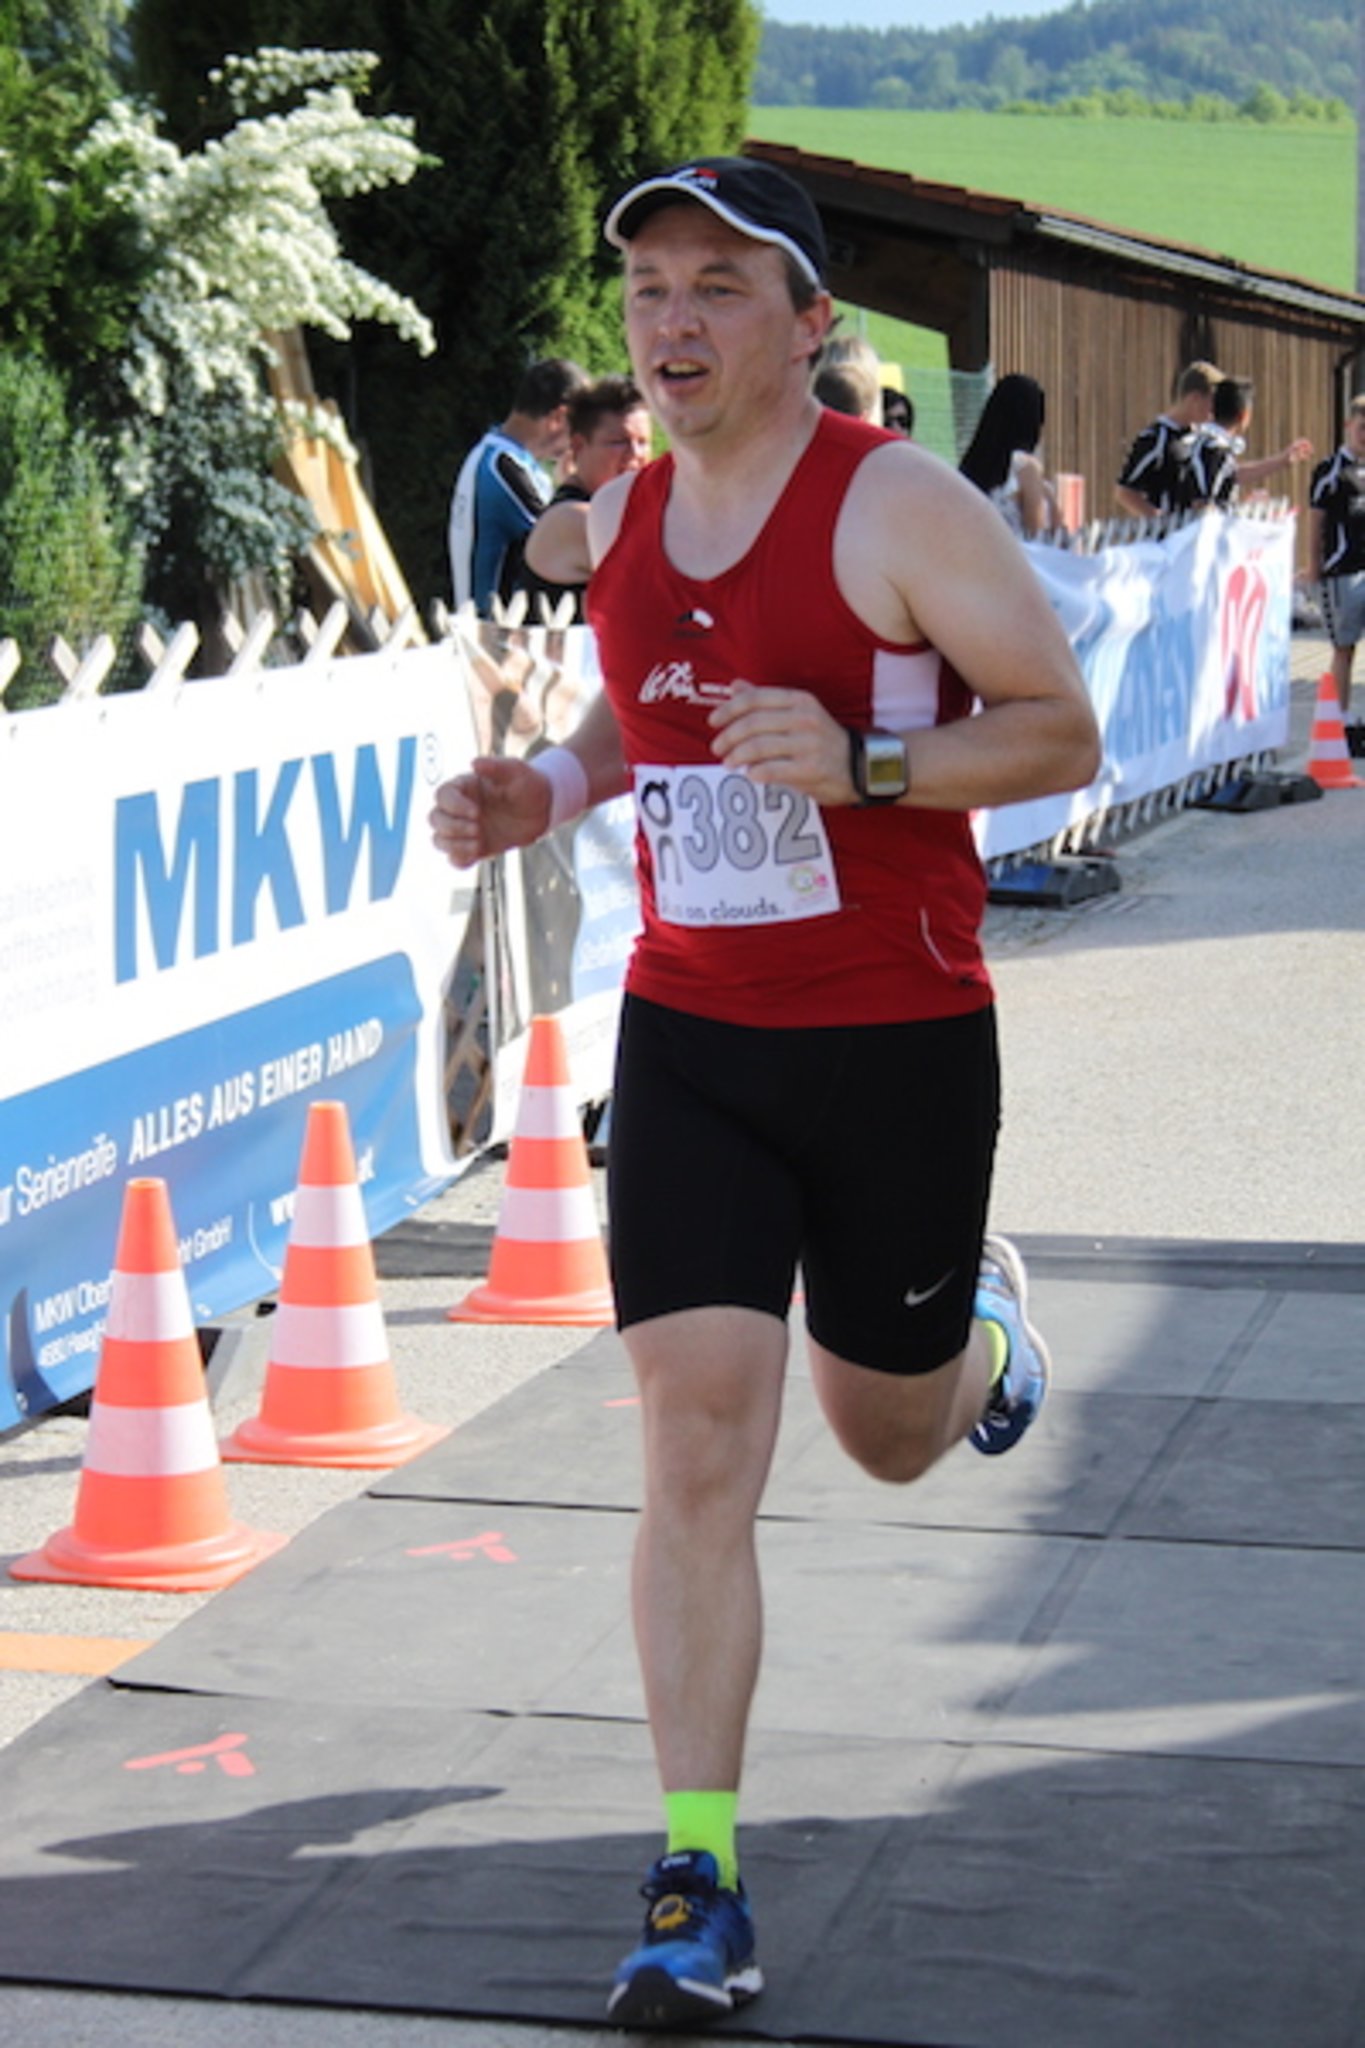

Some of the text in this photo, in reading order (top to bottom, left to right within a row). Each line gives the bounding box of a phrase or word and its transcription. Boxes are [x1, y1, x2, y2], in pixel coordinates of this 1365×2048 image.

[114, 734, 418, 986] MKW
[678, 774, 823, 873] 382
[128, 1091, 204, 1166] ALLES
[207, 1071, 255, 1132] AUS
[259, 1041, 323, 1108] EINER
[326, 1016, 383, 1078] HAND
